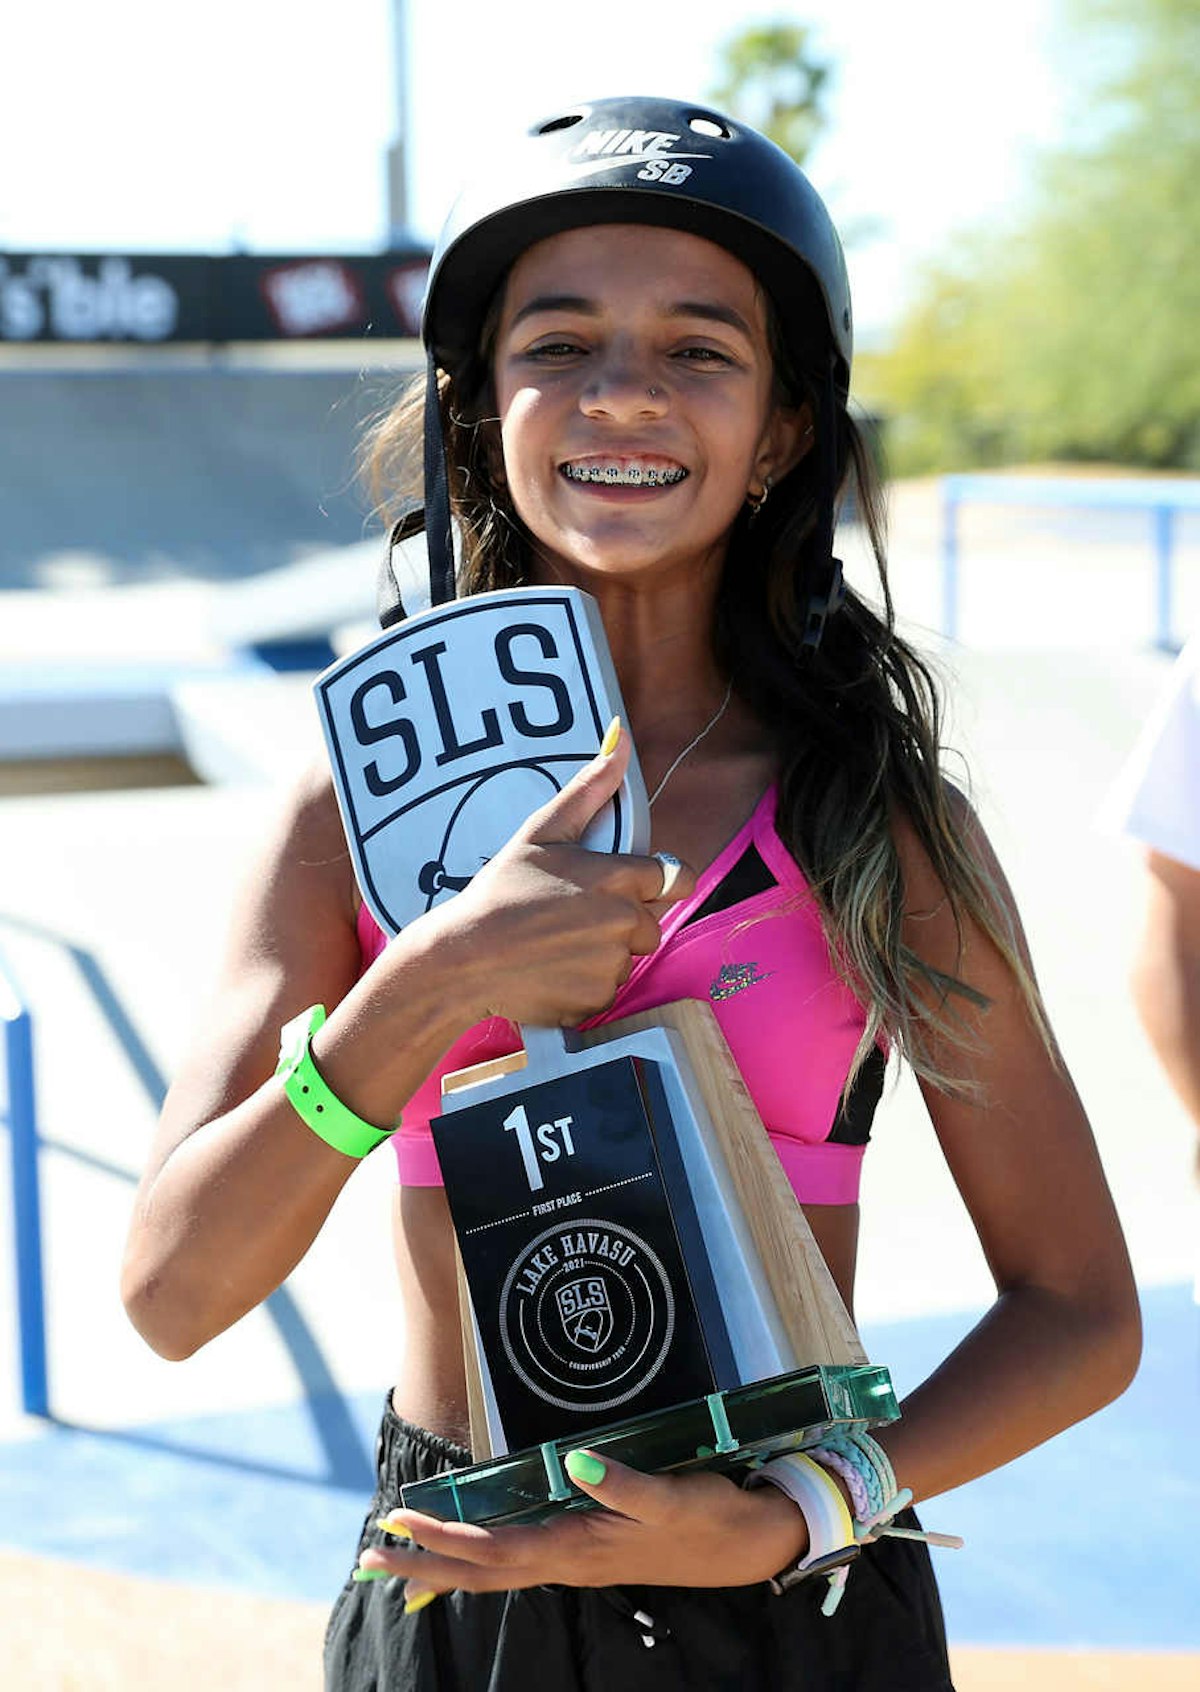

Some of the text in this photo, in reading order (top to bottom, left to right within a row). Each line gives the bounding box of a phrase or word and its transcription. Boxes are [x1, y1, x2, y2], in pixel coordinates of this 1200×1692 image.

[575, 129, 681, 156] NIKE
[637, 159, 693, 185] SB
[350, 623, 574, 797] SLS
[503, 1104, 576, 1192] 1ST
[531, 1191, 582, 1217] FIRST PLACE
[516, 1232, 637, 1296] LAKE HAVASU
[563, 1258, 584, 1273] 2021
[560, 1281, 605, 1316] SLS
